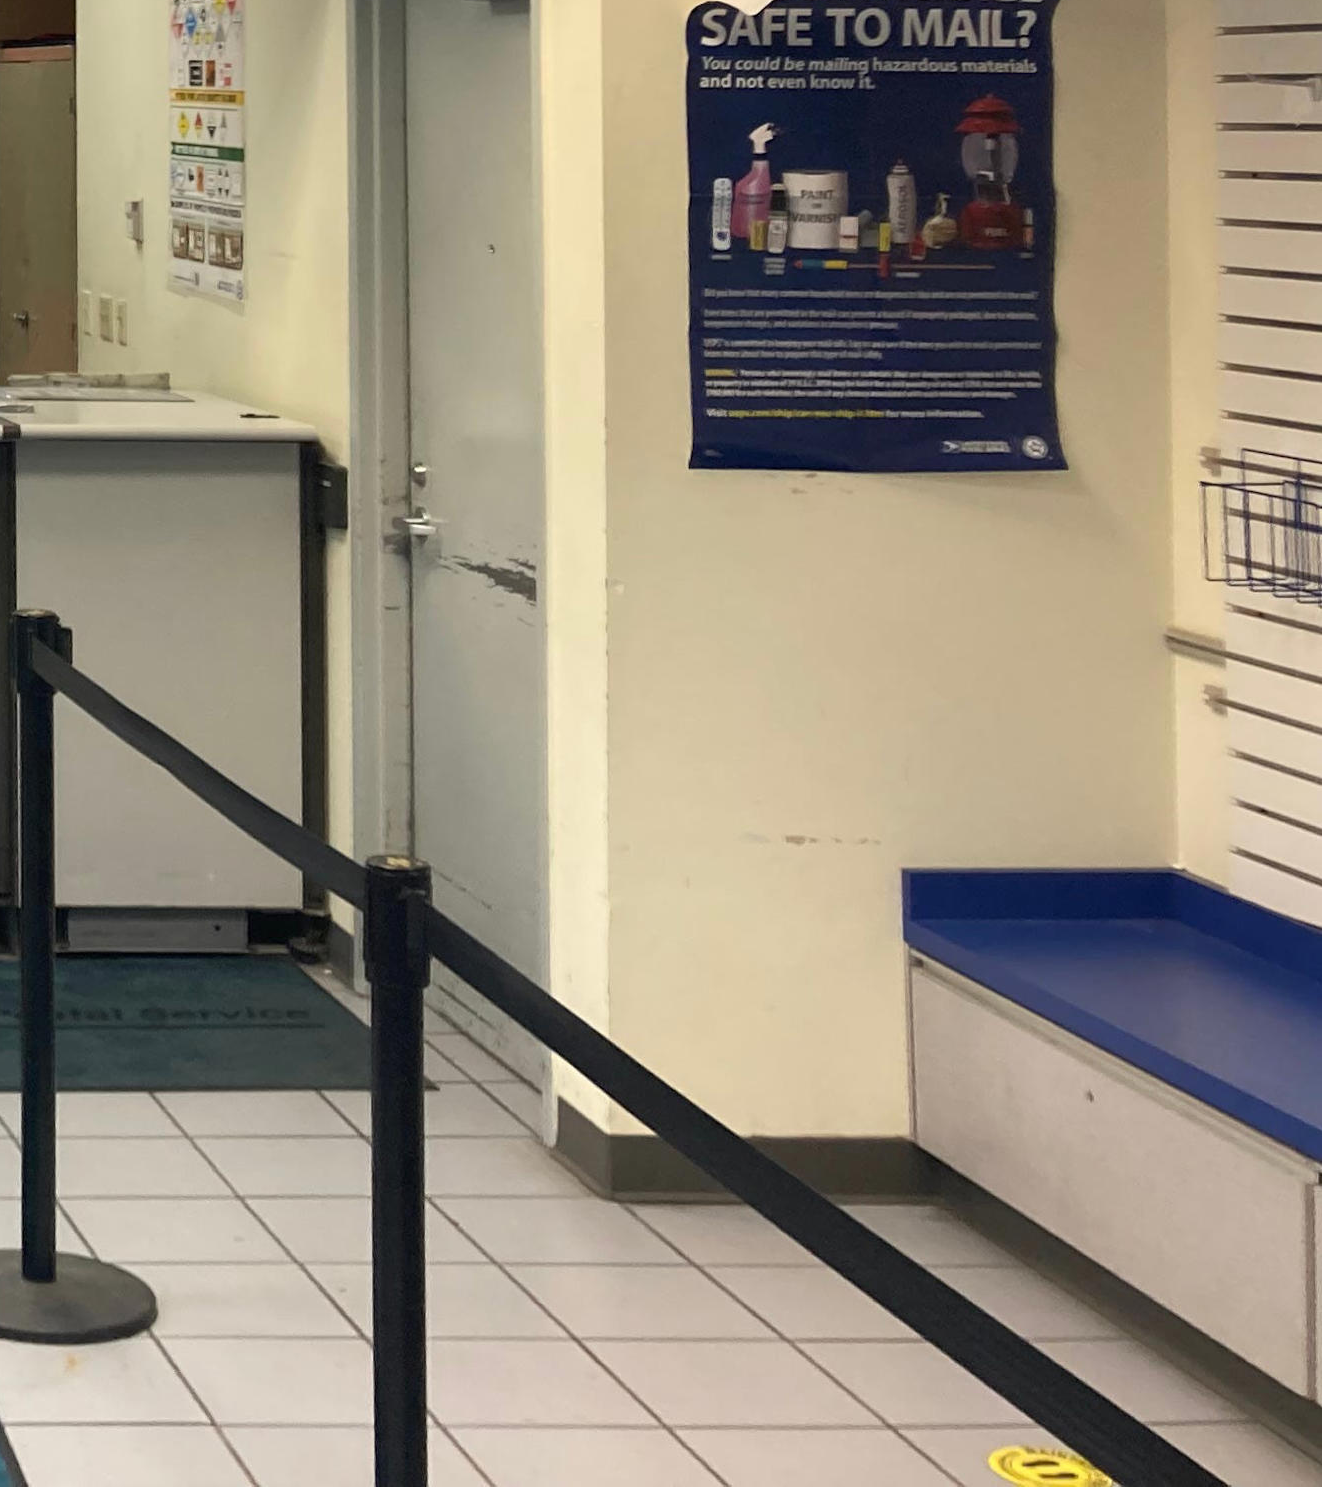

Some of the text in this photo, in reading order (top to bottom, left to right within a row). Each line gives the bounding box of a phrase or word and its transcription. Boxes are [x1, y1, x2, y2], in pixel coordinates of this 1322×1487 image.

[700, 7, 1038, 49] SAFE TO MAIL?
[701, 56, 1038, 76] You could be mailing hazardous materials
[699, 73, 876, 90] and not even know it.
[801, 189, 833, 201] PAINT
